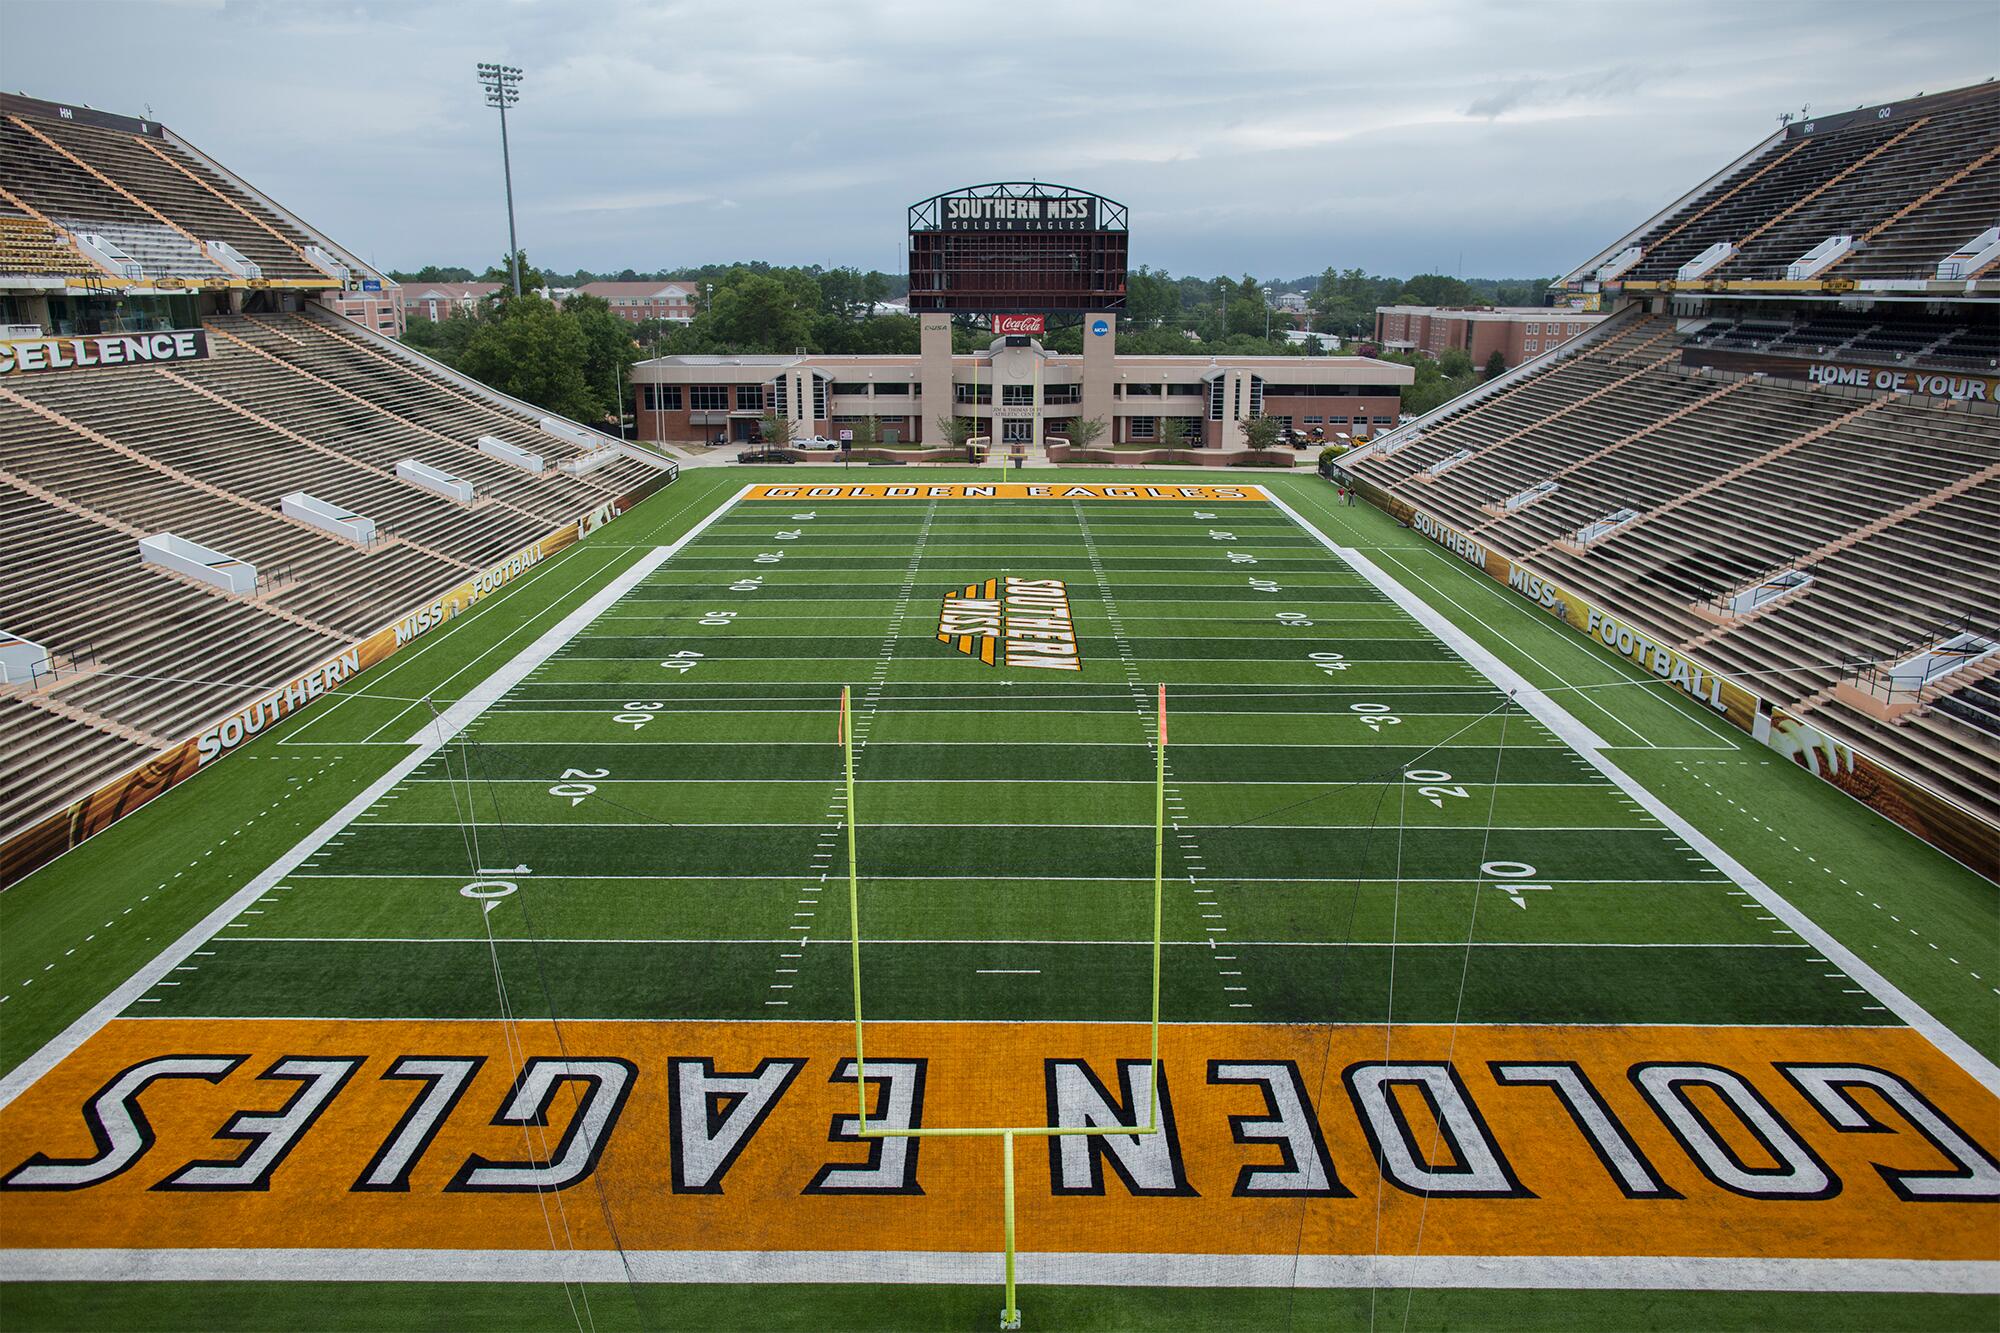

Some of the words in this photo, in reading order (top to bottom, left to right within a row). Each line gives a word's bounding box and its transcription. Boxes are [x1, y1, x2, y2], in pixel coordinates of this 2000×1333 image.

[60, 107, 73, 119] HH
[1879, 107, 1891, 119] QQ
[1804, 123, 1815, 133] RR
[948, 199, 1040, 219] SOUTHERN
[1047, 199, 1088, 219] MISS
[952, 221, 1013, 230] GOLDEN
[1026, 221, 1085, 230] EAGLES
[1002, 317, 1042, 332] Coca-Cola
[1808, 364, 1870, 387] HOME
[1875, 370, 1908, 390] OF
[1916, 374, 1987, 400] YOUR
[763, 486, 996, 497] GOLDEN
[1026, 486, 1247, 498] EAGLES
[699, 611, 738, 625] 50
[938, 598, 1002, 636] MISS
[1275, 612, 1313, 626] 50
[1413, 510, 1488, 569] SOUTHERN
[1508, 561, 1557, 609] MISS
[1586, 607, 1729, 713] FOOTBALL
[1004, 577, 1082, 671] SOUTHERN
[197, 649, 361, 767] SOUTHERN
[393, 600, 444, 648] MISS
[471, 544, 545, 600] FOOTBALL
[660, 650, 704, 668] 40
[1308, 652, 1352, 670] 40
[613, 702, 664, 723] 30
[1350, 703, 1402, 724] 30
[549, 768, 610, 796] 20
[1405, 770, 1470, 798] 20
[460, 864, 533, 898] 10
[1480, 861, 1553, 895] 10
[0, 1053, 929, 1196] EAGLES
[1044, 1057, 2000, 1202] GOLDEN
